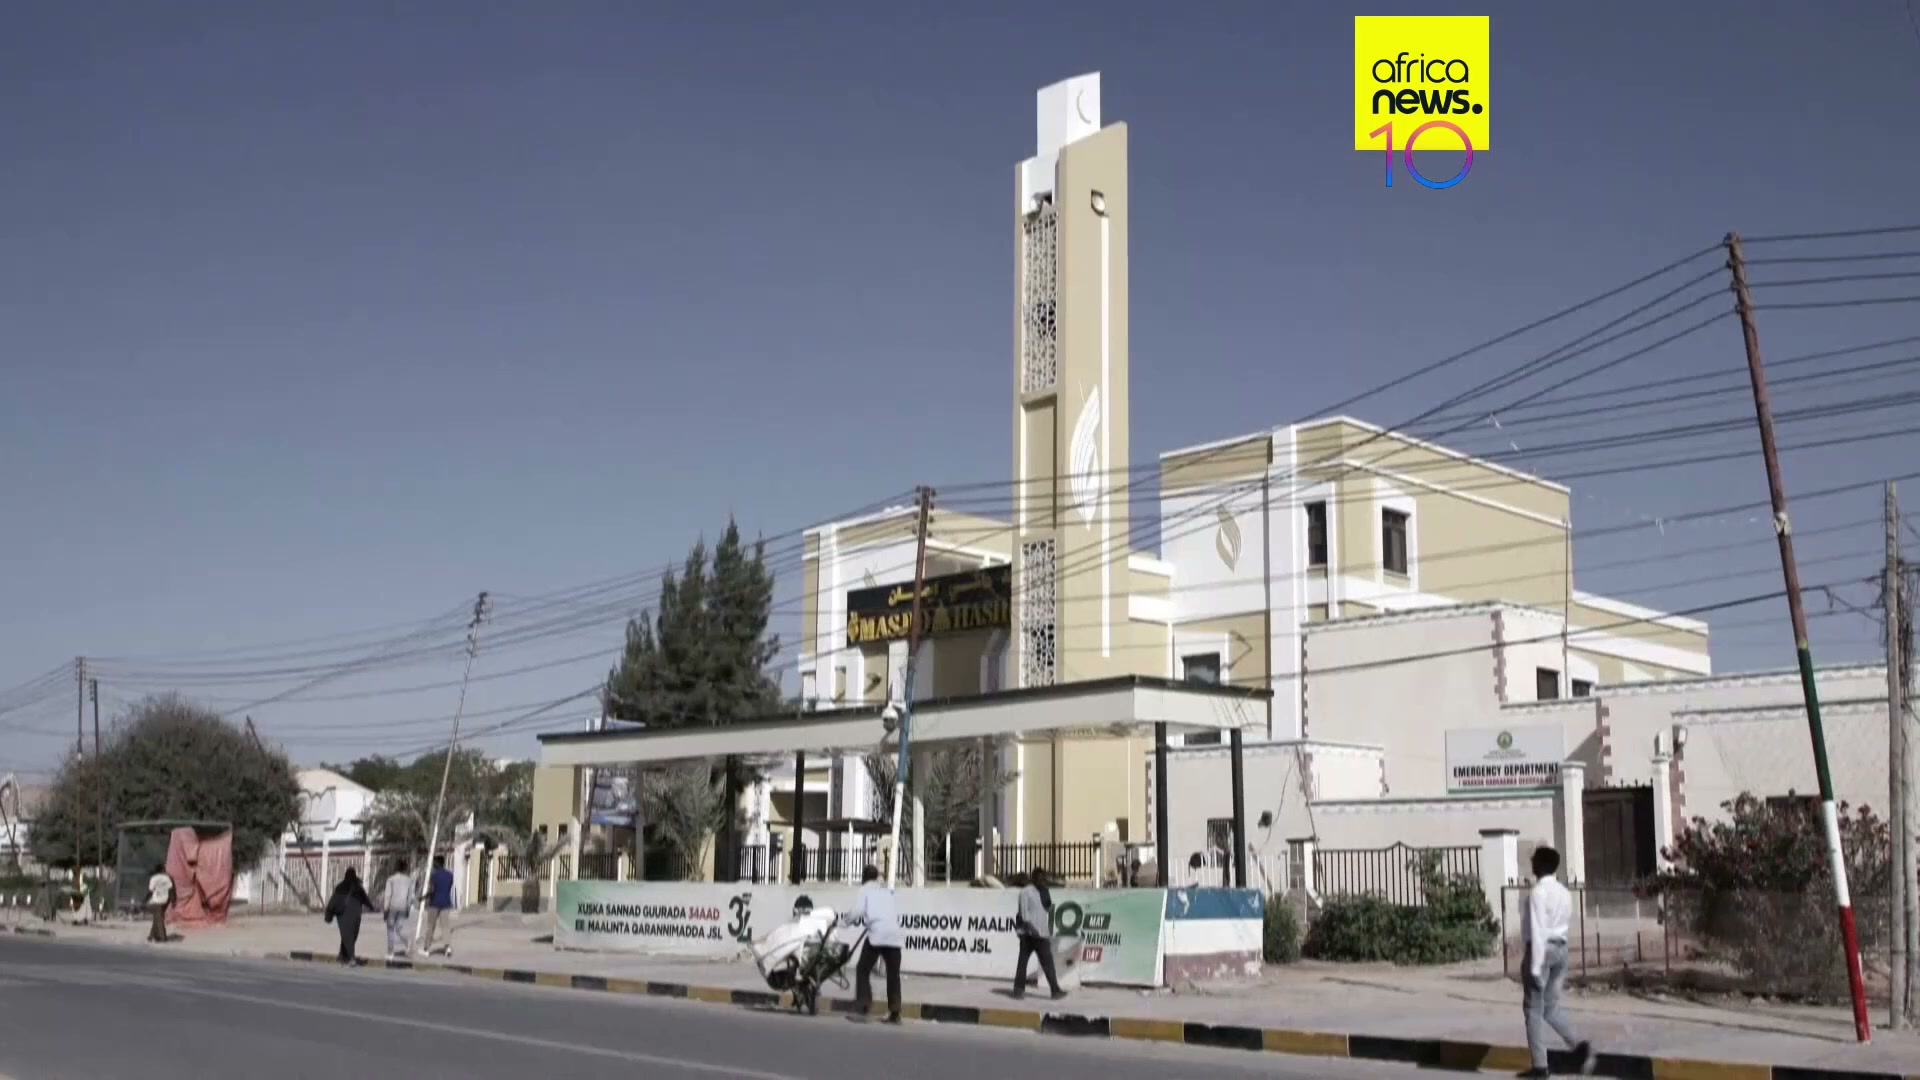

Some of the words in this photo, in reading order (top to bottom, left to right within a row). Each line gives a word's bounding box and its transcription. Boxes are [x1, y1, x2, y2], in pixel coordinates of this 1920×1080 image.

[1453, 765, 1501, 778] EMERGENCY
[1504, 762, 1558, 776] DEPARTMENT
[577, 902, 604, 916] XUSKA
[606, 904, 641, 918] SANNAD
[643, 905, 687, 919] GUURADA
[688, 907, 720, 921] 34AAD
[968, 915, 1017, 933] MAALIN
[1089, 915, 1105, 927] MAY
[575, 919, 585, 932] EE
[588, 921, 630, 935] MAALINTA
[632, 922, 705, 938] QARANNIMADDA
[706, 926, 723, 940] JSL
[970, 937, 992, 954] JSL
[1086, 932, 1122, 946] NATIONAL
[1086, 949, 1100, 961] DAY
